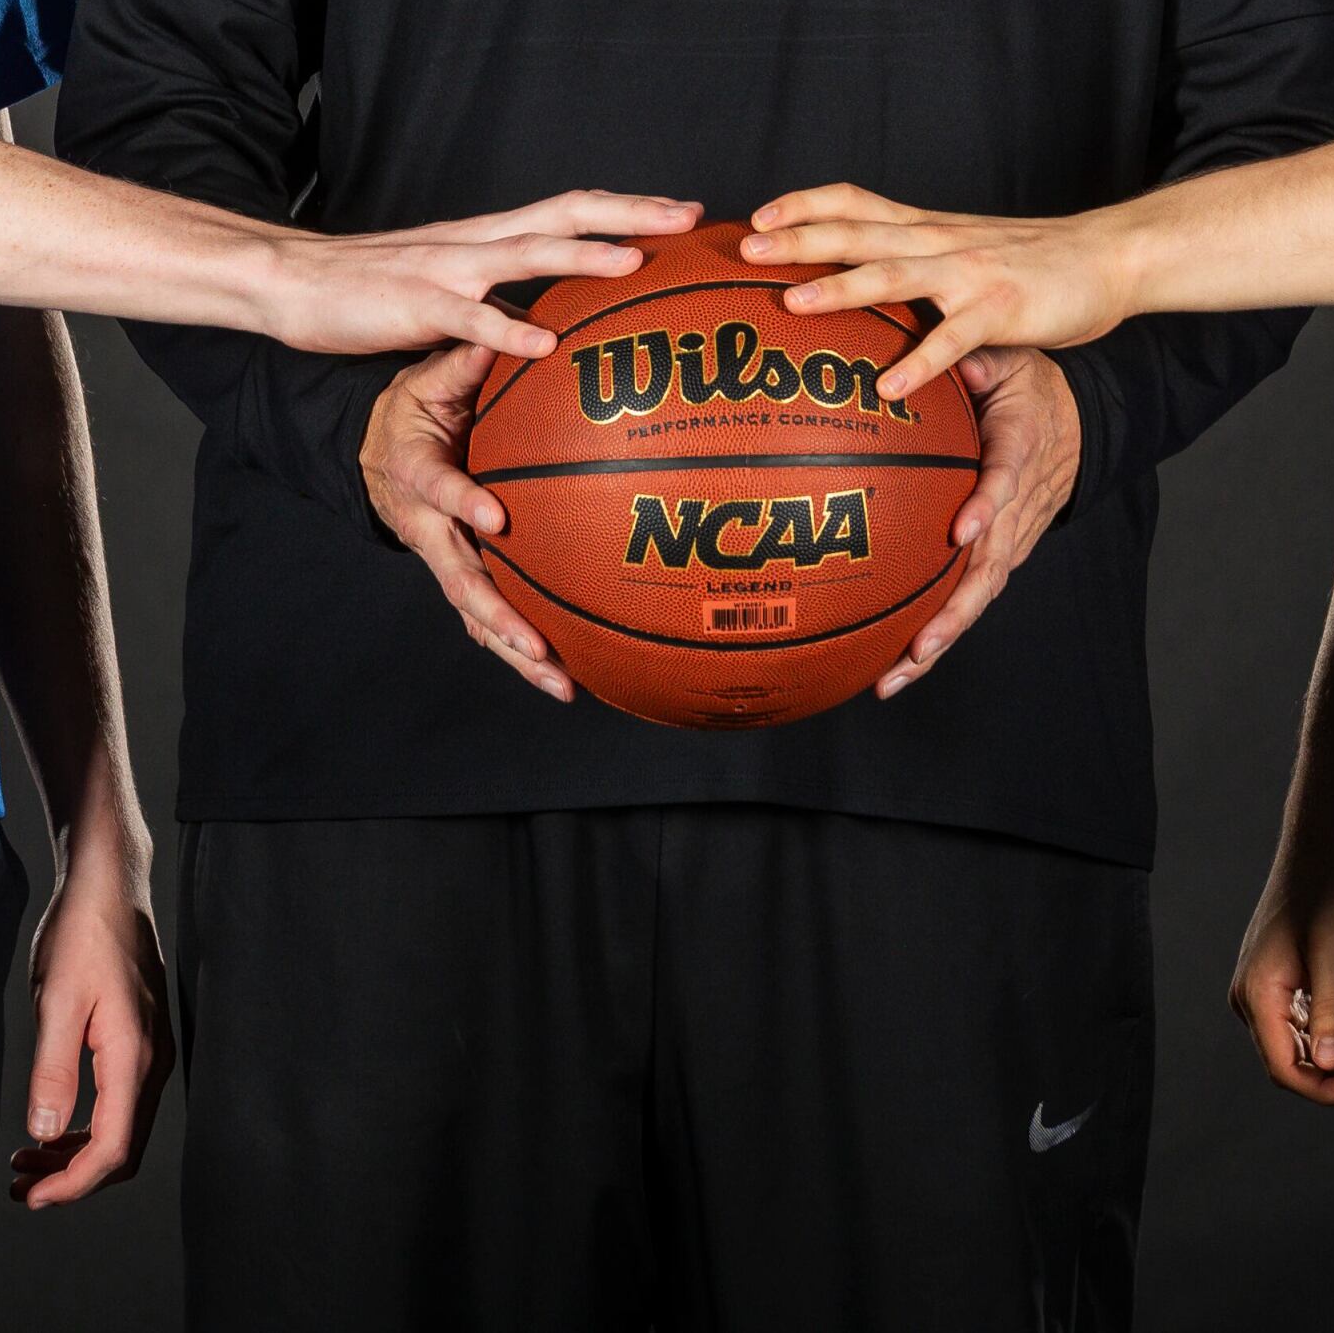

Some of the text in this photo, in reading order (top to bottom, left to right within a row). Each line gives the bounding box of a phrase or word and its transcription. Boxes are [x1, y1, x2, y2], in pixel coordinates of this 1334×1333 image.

[571, 320, 913, 425] Wilson
[626, 413, 881, 441] PERFORMANCE COMPOSITE
[623, 488, 872, 571] NCAA
[706, 579, 793, 594] LEGEND
